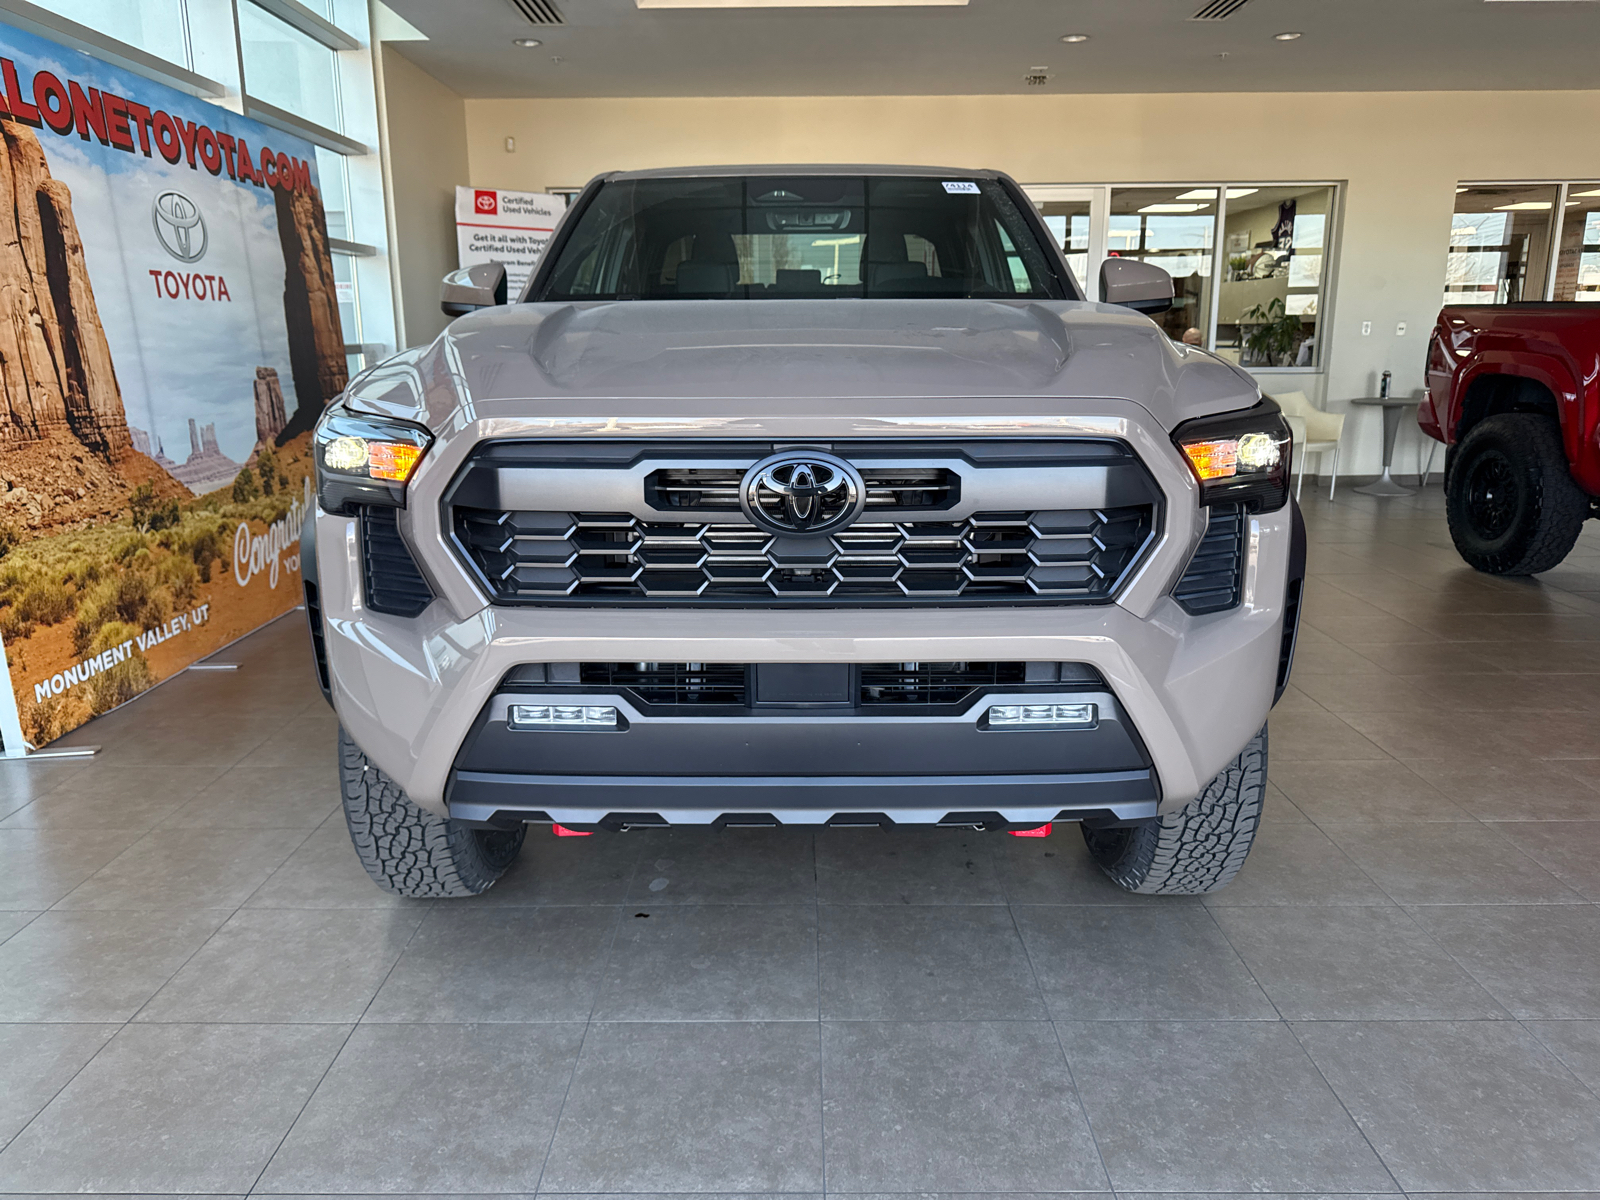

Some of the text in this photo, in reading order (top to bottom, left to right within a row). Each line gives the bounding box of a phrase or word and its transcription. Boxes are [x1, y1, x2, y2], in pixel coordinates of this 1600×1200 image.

[502, 195, 534, 206] Certified
[502, 204, 551, 216] Used Vehicles
[473, 233, 489, 243] Get
[490, 234, 497, 243] it
[498, 234, 509, 244] all
[509, 236, 528, 245] with
[469, 243, 543, 256] Certified Used Veh
[149, 269, 231, 302] TOYOTA
[34, 604, 209, 703] MONUMENT VALLEY, UT
